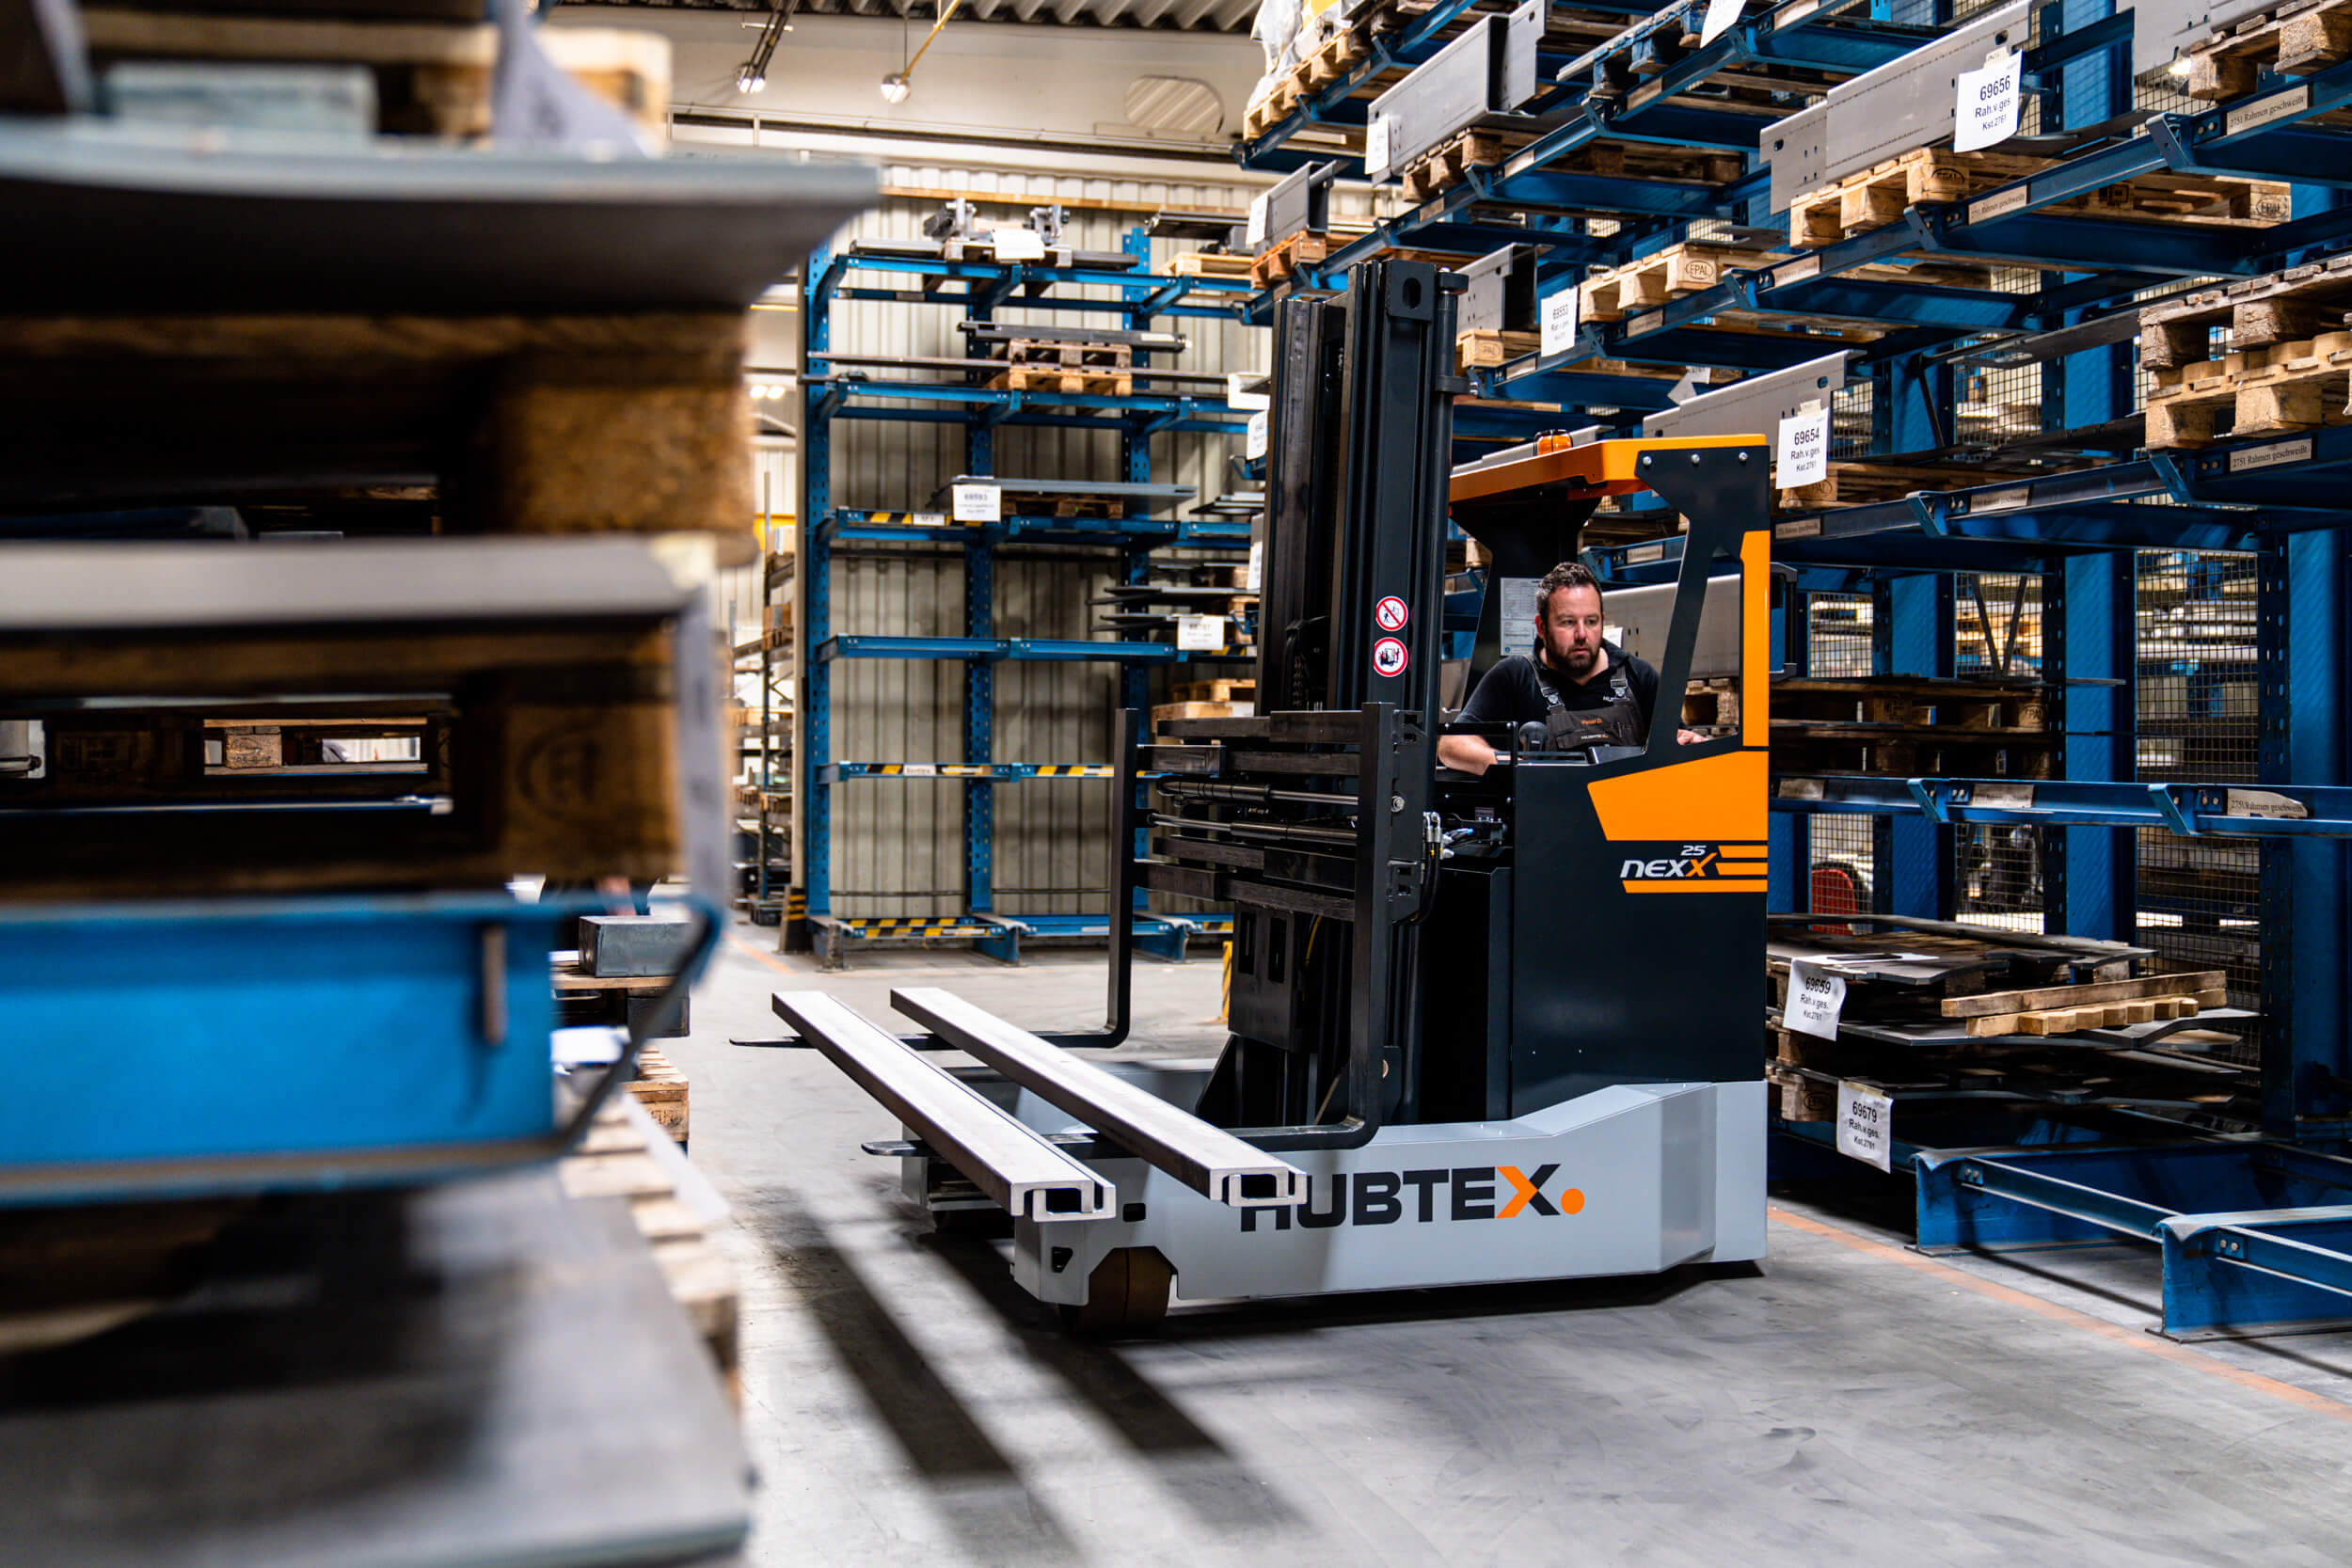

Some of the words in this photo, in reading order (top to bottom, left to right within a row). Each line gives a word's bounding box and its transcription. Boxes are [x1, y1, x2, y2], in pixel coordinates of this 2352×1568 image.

[1979, 75, 2010, 101] 69656
[2244, 108, 2268, 121] Rahmen
[1794, 427, 1820, 446] 69654
[2233, 457, 2246, 467] 2751
[2248, 452, 2271, 464] Rahmen
[2272, 444, 2308, 461] geschweißt
[1680, 845, 1707, 856] 25
[1805, 977, 1832, 994] 69659
[1852, 1101, 1878, 1123] 69679
